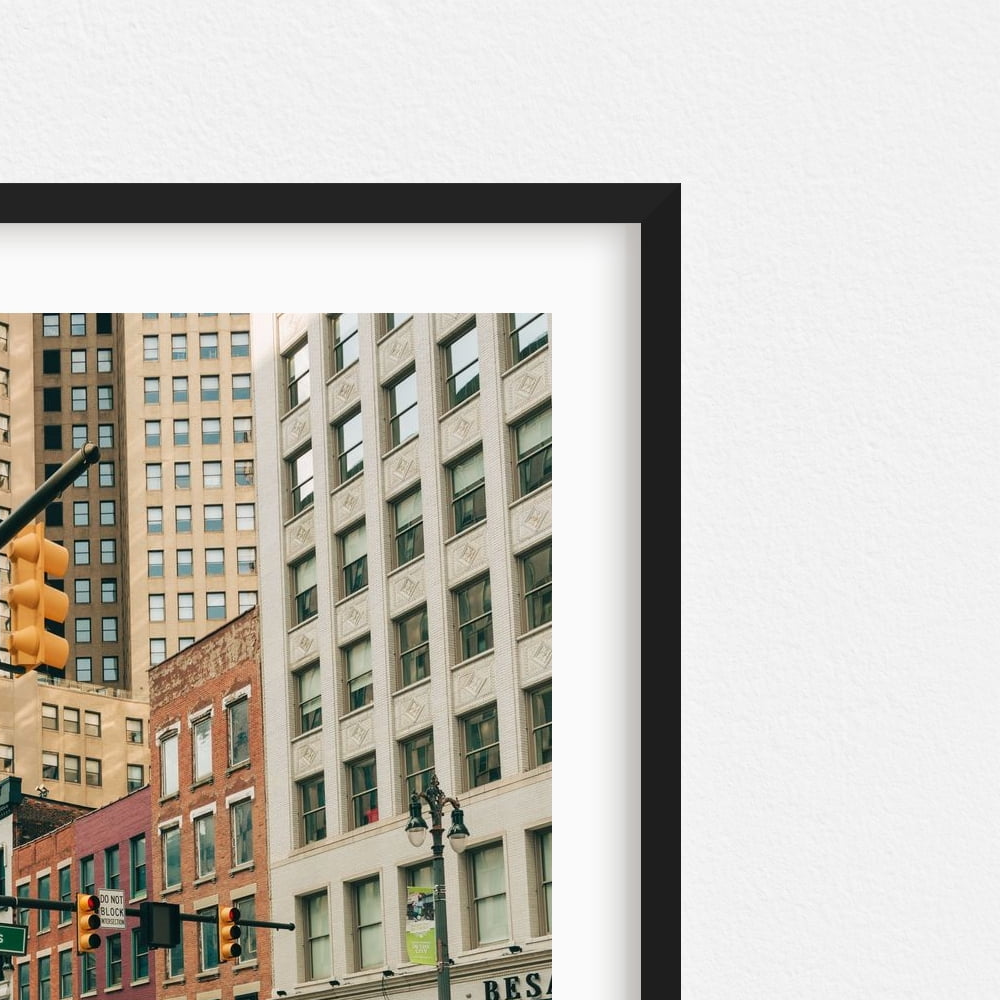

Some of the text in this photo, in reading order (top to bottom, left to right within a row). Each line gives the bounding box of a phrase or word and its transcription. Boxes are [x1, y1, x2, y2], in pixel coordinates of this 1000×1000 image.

[100, 894, 123, 905] DO NOT
[100, 907, 124, 917] BLOCK
